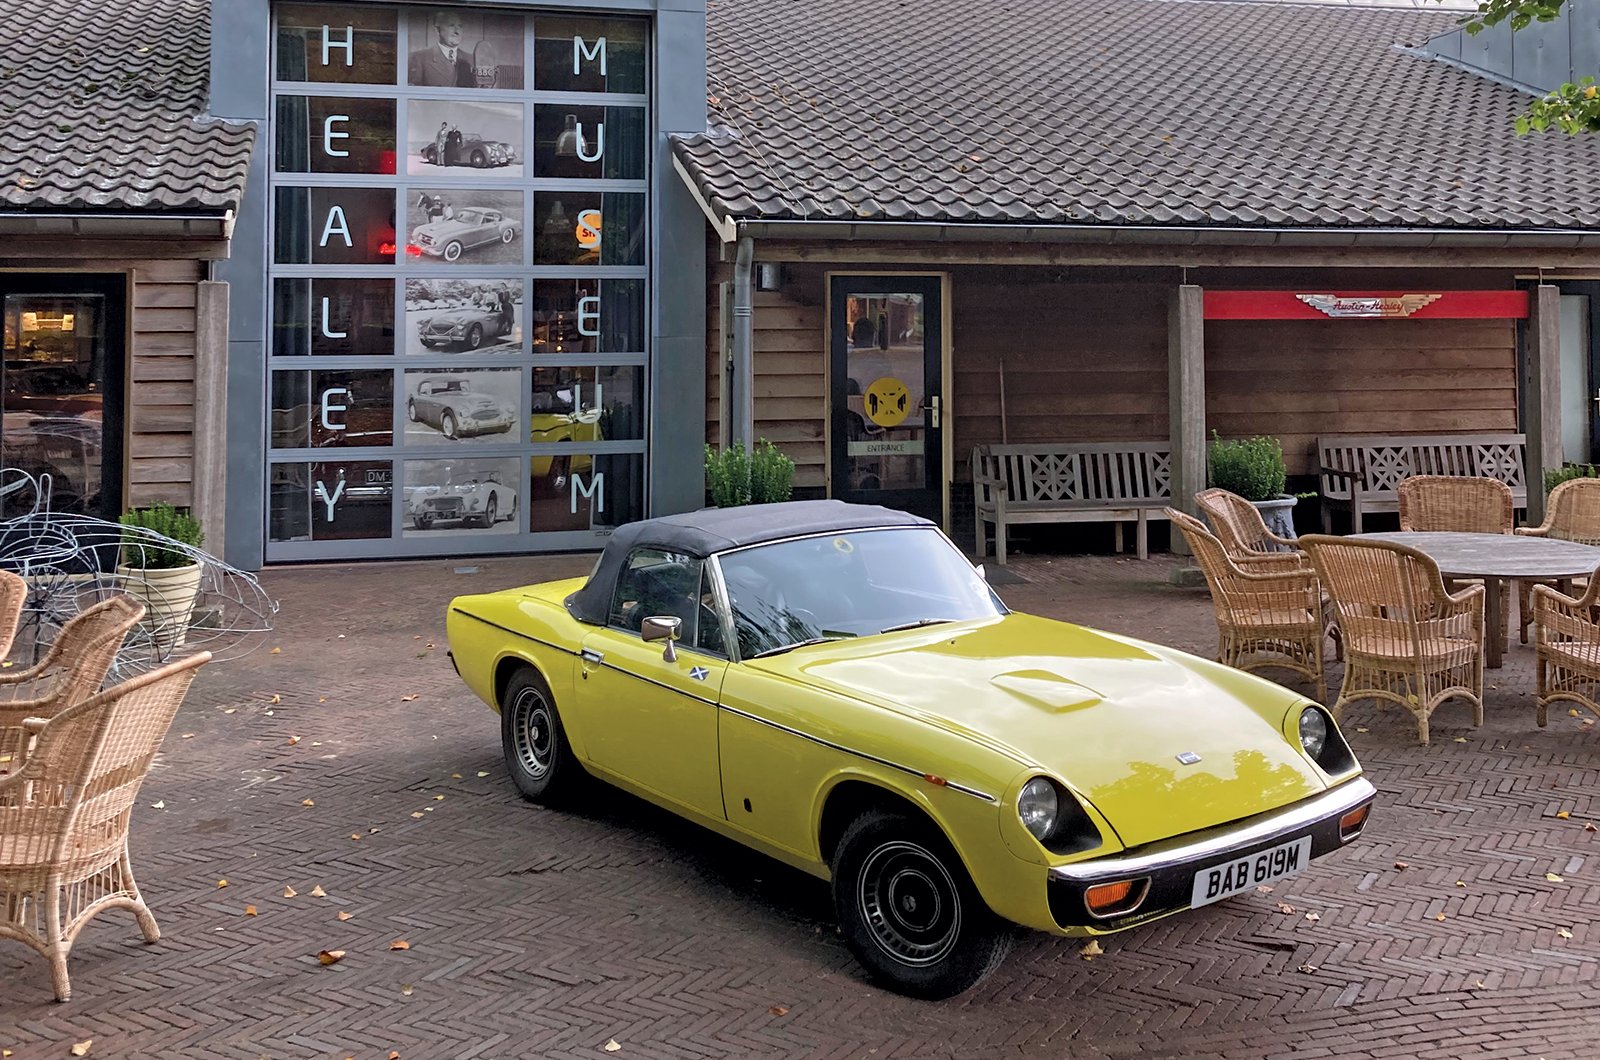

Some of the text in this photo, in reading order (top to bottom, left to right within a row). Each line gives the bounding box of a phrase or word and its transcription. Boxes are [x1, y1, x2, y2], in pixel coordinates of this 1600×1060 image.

[316, 25, 354, 522] HEALEY
[570, 36, 607, 514] MUSEUM
[1332, 299, 1404, 312] Austin-Healey
[866, 444, 905, 452] ENTRANCE
[1206, 844, 1300, 899] BAB 619M
